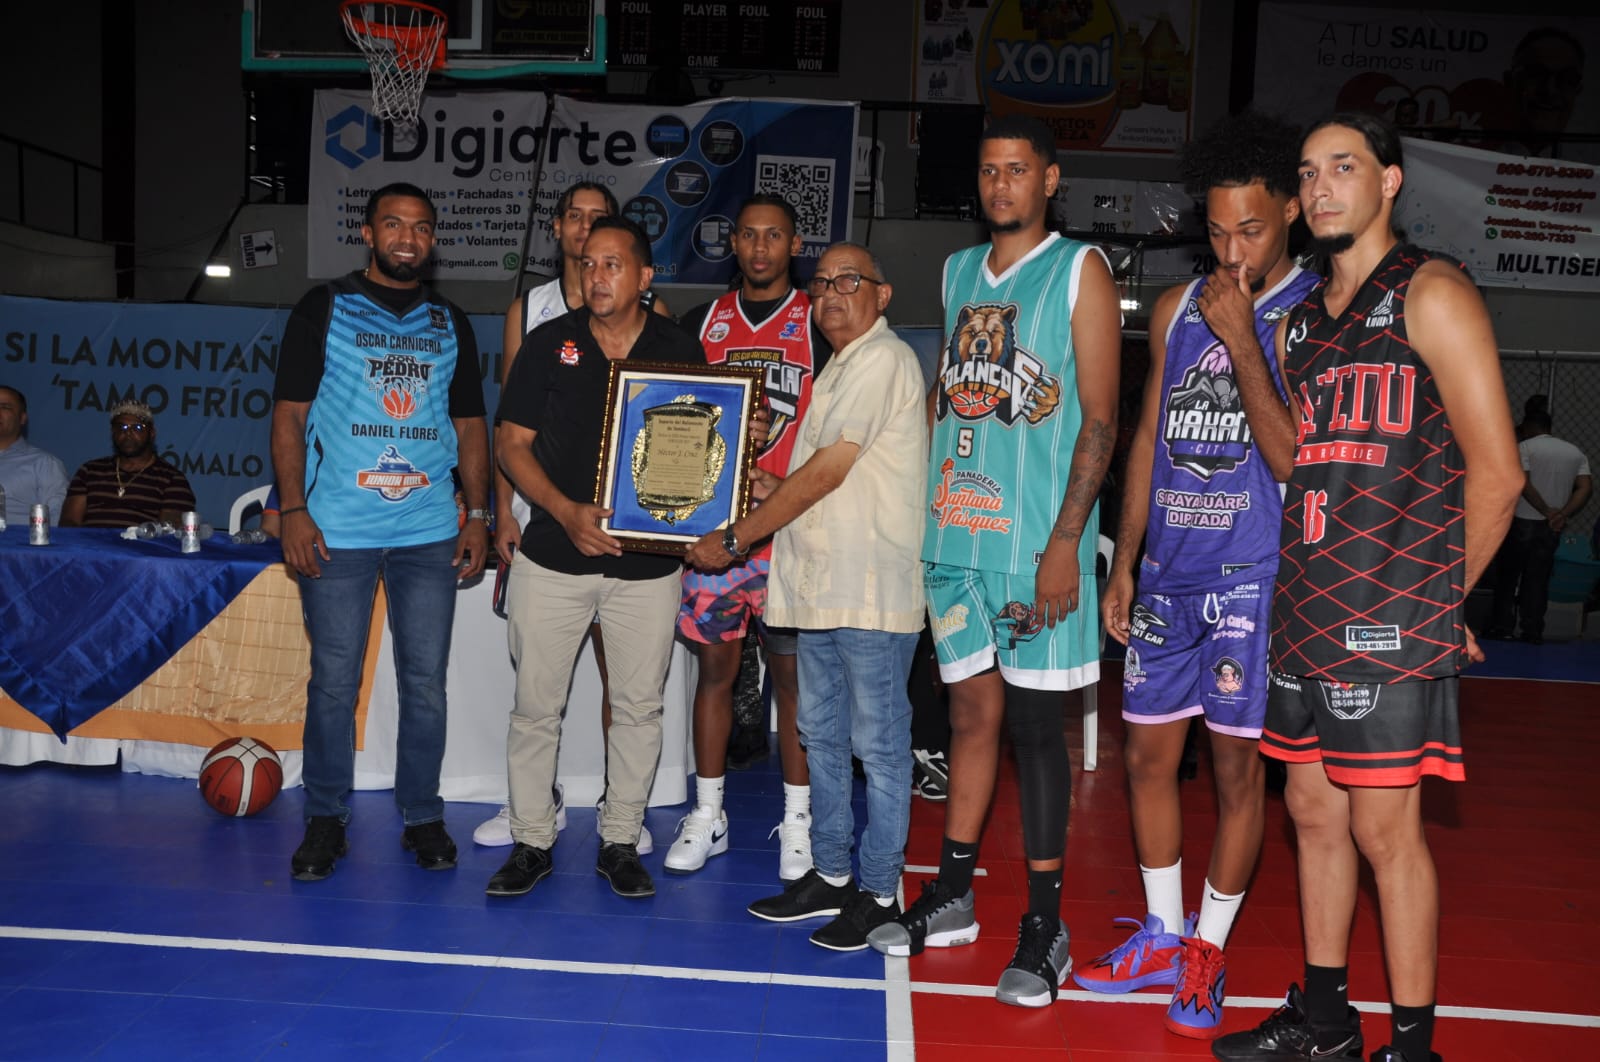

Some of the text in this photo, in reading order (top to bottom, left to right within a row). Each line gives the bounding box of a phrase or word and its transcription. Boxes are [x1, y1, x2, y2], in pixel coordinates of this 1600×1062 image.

[621, 2, 652, 14] FOUL
[683, 3, 728, 17] PLAYER
[739, 4, 770, 17] FOUL
[796, 7, 827, 19] FOUL
[1319, 23, 1489, 53] A TU SALUD
[621, 54, 648, 65] WON
[688, 56, 720, 68] GAME
[797, 58, 823, 71] WON
[1317, 48, 1448, 72] le damos un
[383, 109, 636, 178] Digiarte
[345, 188, 376, 198] Letre
[457, 188, 513, 199] Fachadas
[1094, 195, 1117, 209] 2011
[345, 204, 368, 216] Imp
[452, 204, 521, 215] Letreros 3D
[345, 219, 365, 229] Uni
[466, 236, 518, 246] Volantes
[242, 234, 256, 267] CANTINA
[797, 246, 827, 257] EAM
[356, 333, 387, 348] OSCAR
[390, 335, 442, 354] CARNICERIA
[6, 332, 278, 375] SI LA MONTAÑ
[386, 354, 415, 363] DON
[367, 358, 434, 380] PEDRO
[181, 379, 272, 419] FRÍO
[1195, 400, 1209, 411] LA
[351, 424, 438, 441] DANIEL FLORES
[957, 428, 974, 458] 5
[161, 445, 263, 478] ÓMALO
[956, 471, 1002, 494] PANADERIA
[934, 471, 1003, 510] Santana
[938, 505, 1011, 534] Vasquez
[1144, 632, 1164, 646] CAR
